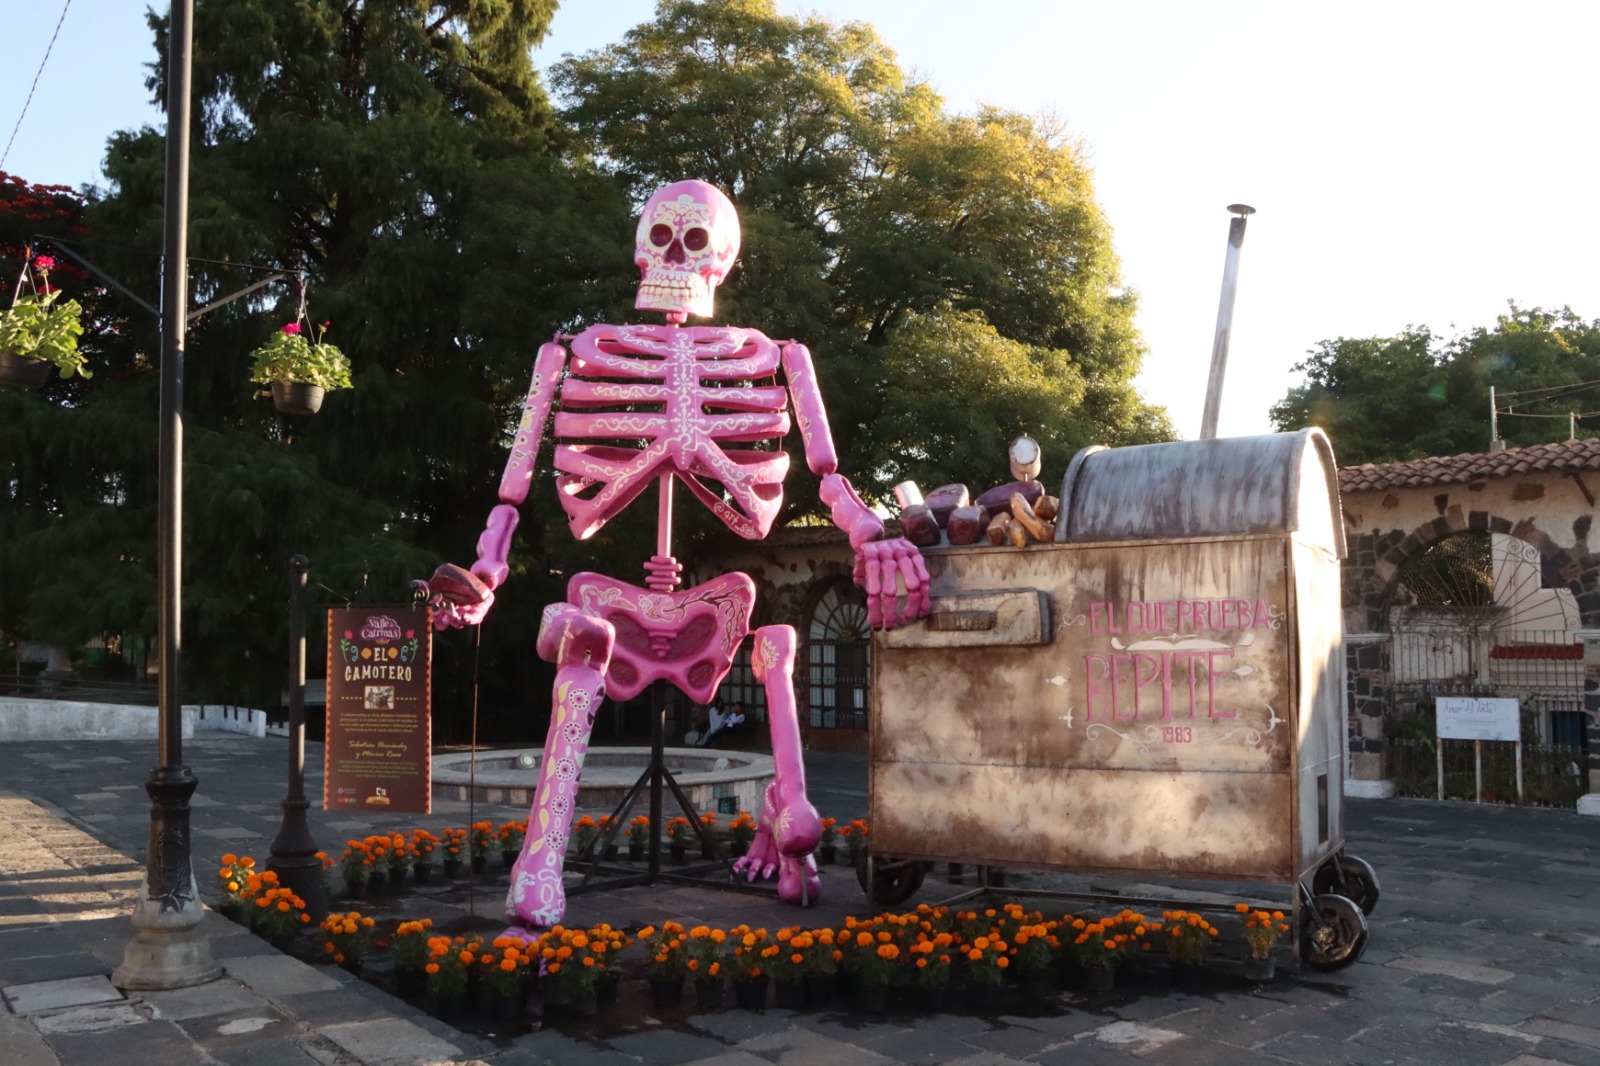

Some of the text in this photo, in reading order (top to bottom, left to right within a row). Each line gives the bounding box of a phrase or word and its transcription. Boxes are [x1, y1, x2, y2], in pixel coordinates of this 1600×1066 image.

[369, 618, 389, 629] Valle
[1089, 598, 1272, 634] EL QUE PRUEBA
[361, 628, 399, 639] Catrinas
[373, 647, 388, 662] EL
[344, 665, 412, 682] CAMOTERO
[1082, 648, 1237, 723] REPITE
[1162, 726, 1192, 743] 1983
